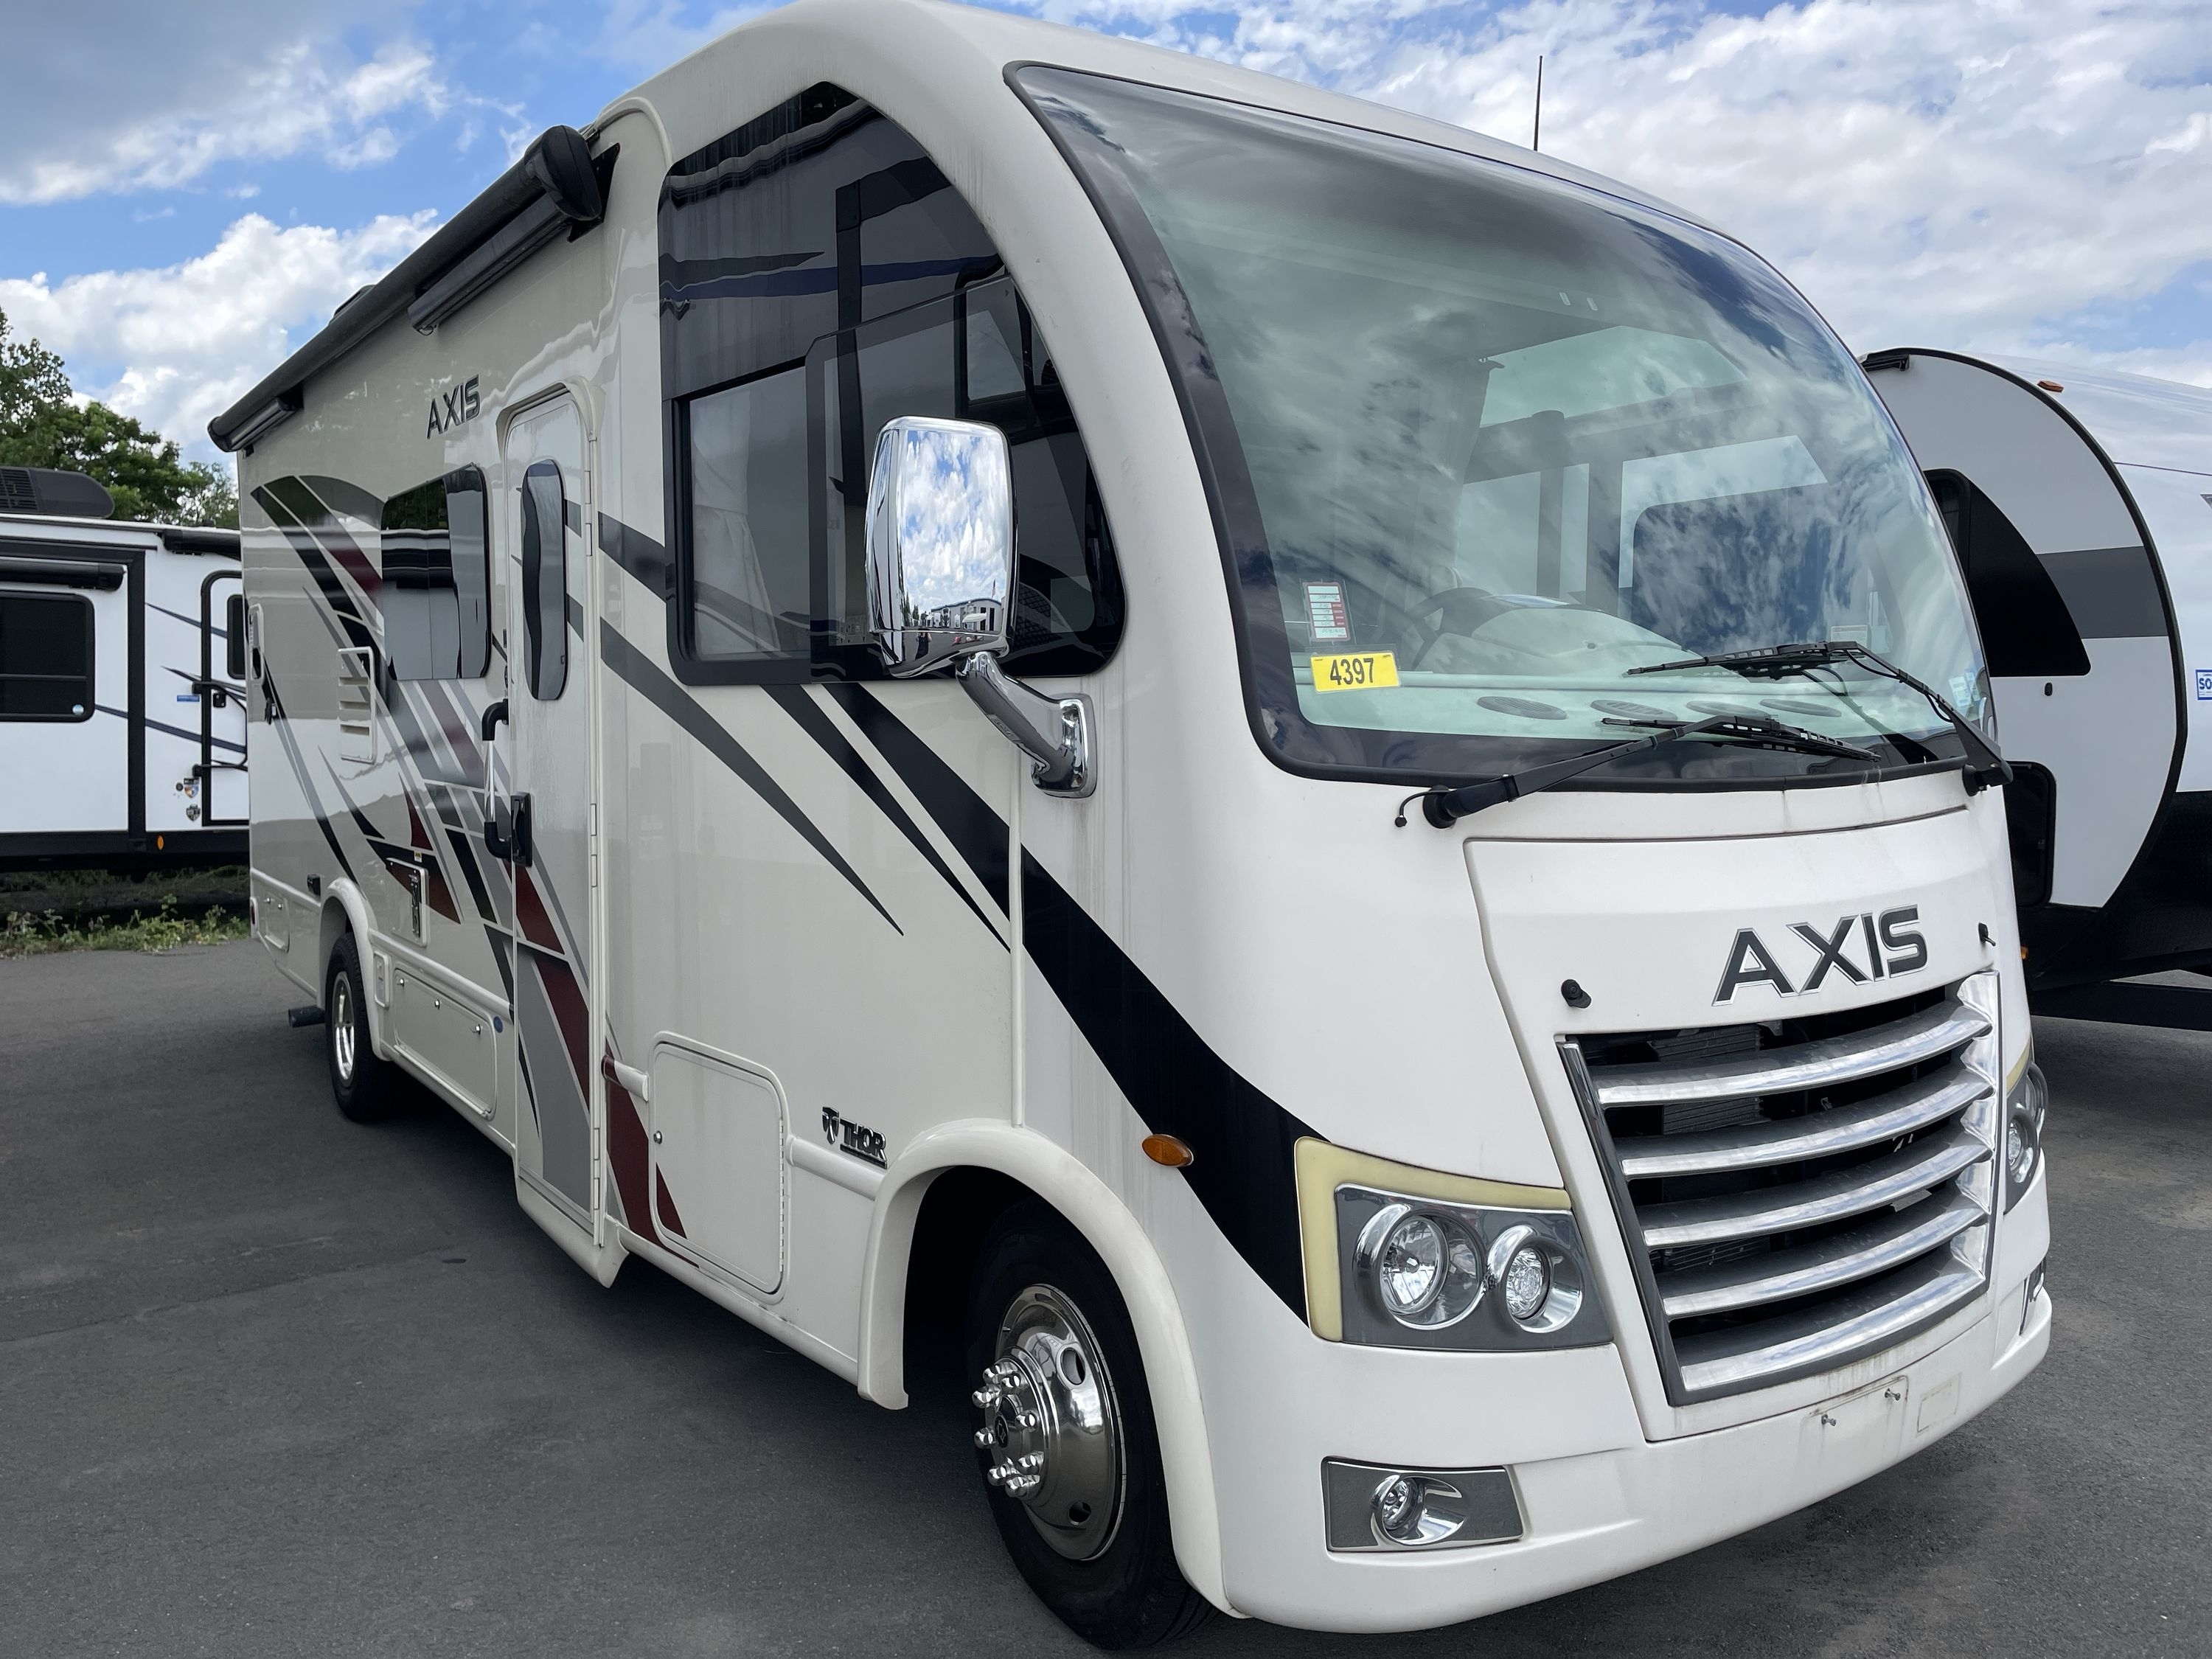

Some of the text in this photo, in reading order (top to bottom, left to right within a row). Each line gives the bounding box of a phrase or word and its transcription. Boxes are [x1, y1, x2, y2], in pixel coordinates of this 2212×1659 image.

[427, 374, 481, 439] AXIS
[1329, 658, 1374, 685] 4397
[2199, 678, 2212, 690] SO
[1711, 903, 1928, 1006] AXIS
[840, 1117, 887, 1162] THOR
